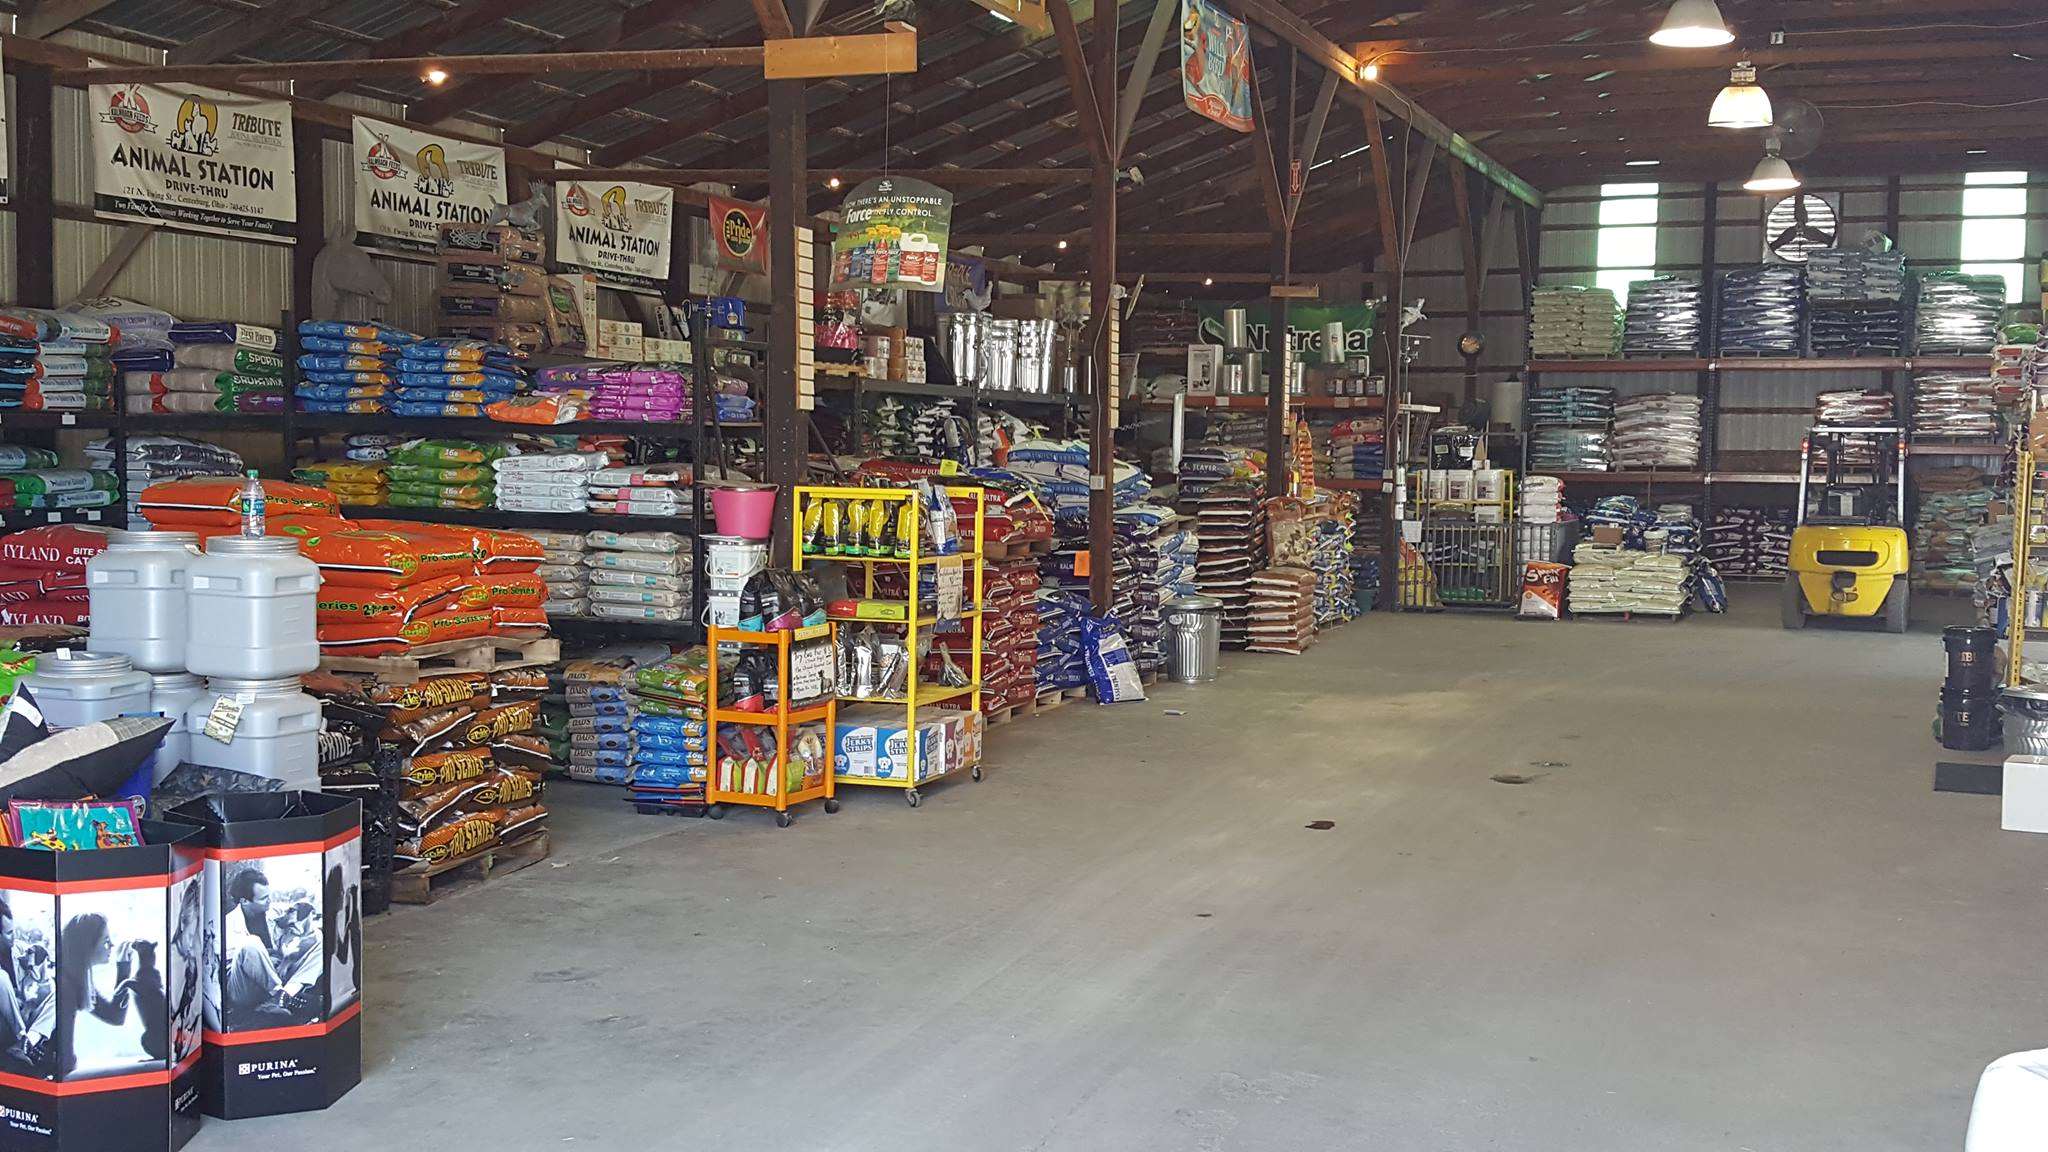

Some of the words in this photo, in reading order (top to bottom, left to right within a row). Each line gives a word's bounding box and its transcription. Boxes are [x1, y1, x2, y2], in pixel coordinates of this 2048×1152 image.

[232, 112, 282, 137] TRIBUTE
[111, 143, 190, 178] ANIMAL
[199, 159, 274, 191] STATION
[457, 160, 498, 179] TRIBUTE
[166, 179, 228, 199] DRIVE-THRU
[370, 188, 430, 217] ANIMAL
[634, 199, 668, 216] TRIBUTE
[891, 196, 942, 205] UNSTOPPABLE
[409, 219, 440, 230] DRIVE-T
[569, 224, 616, 249] ANIMAL
[621, 235, 660, 257] STATION
[598, 250, 635, 264] DRIVE-THRU
[1246, 323, 1367, 353] Ntrea
[73, 547, 94, 556] BITE
[420, 554, 438, 563] Pro
[492, 587, 508, 596] Pro
[317, 601, 358, 611] eries
[425, 680, 443, 708] PRO
[442, 678, 475, 702] SERIES
[493, 712, 509, 738] PRO
[505, 706, 534, 732] SERIES
[847, 736, 872, 746] JERKY
[847, 745, 873, 753] STRIPS
[890, 738, 908, 748] JER
[890, 748, 908, 756] STRI
[440, 761, 456, 784] PRO
[453, 754, 485, 780] SERIES
[498, 778, 513, 804] PRO
[511, 774, 533, 800] SERIES
[450, 831, 466, 858] PRO
[463, 819, 496, 851] SERIES
[251, 1060, 297, 1072] PURINA
[6, 1108, 38, 1124] PURINA
